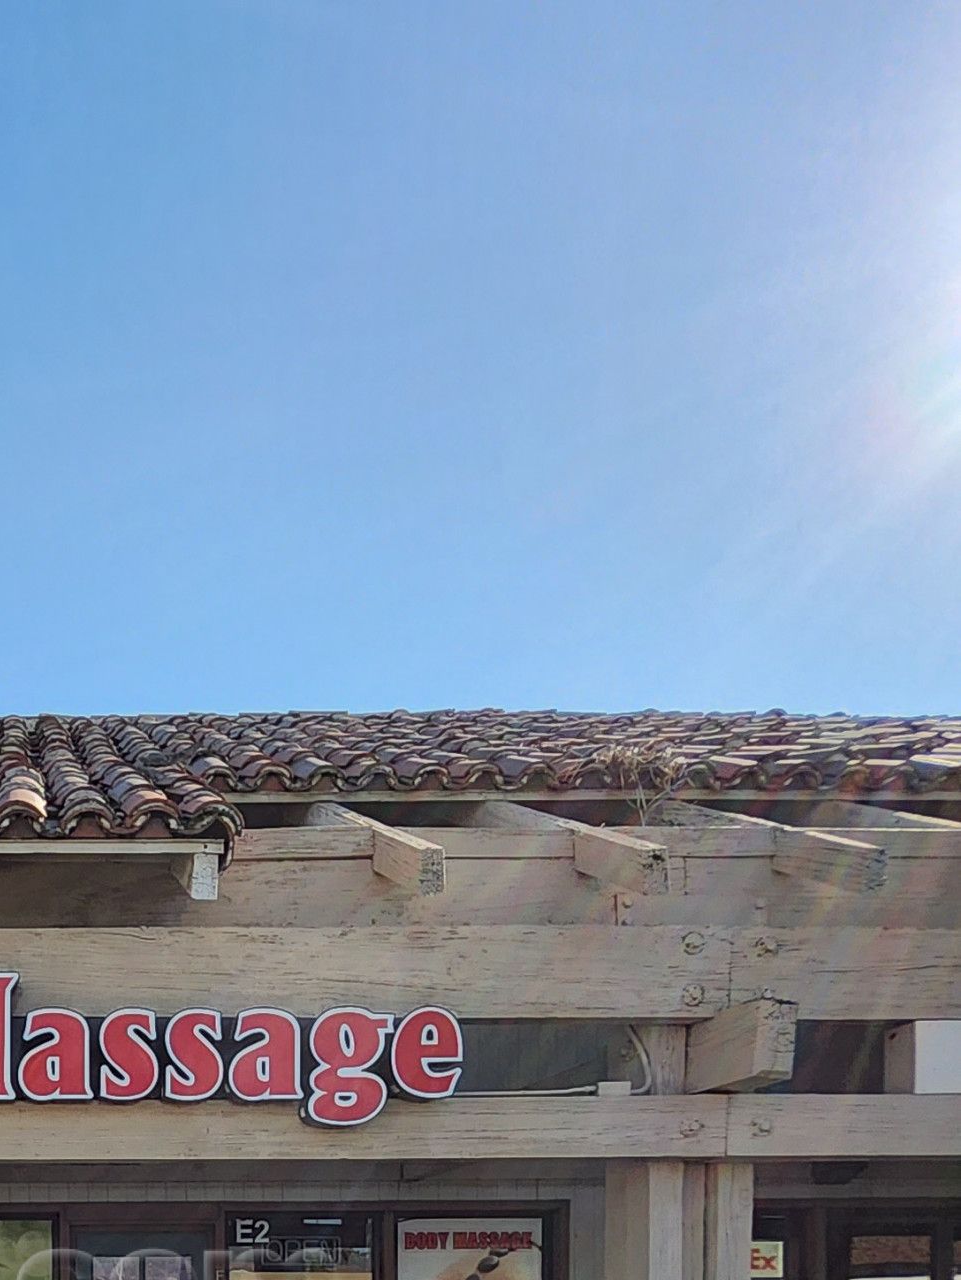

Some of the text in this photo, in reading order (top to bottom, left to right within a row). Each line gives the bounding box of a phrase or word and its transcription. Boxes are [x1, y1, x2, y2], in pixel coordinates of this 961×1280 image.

[236, 1219, 270, 1243] E2
[404, 1231, 533, 1249] BODY MASSAGE
[265, 1239, 338, 1263] OPEN
